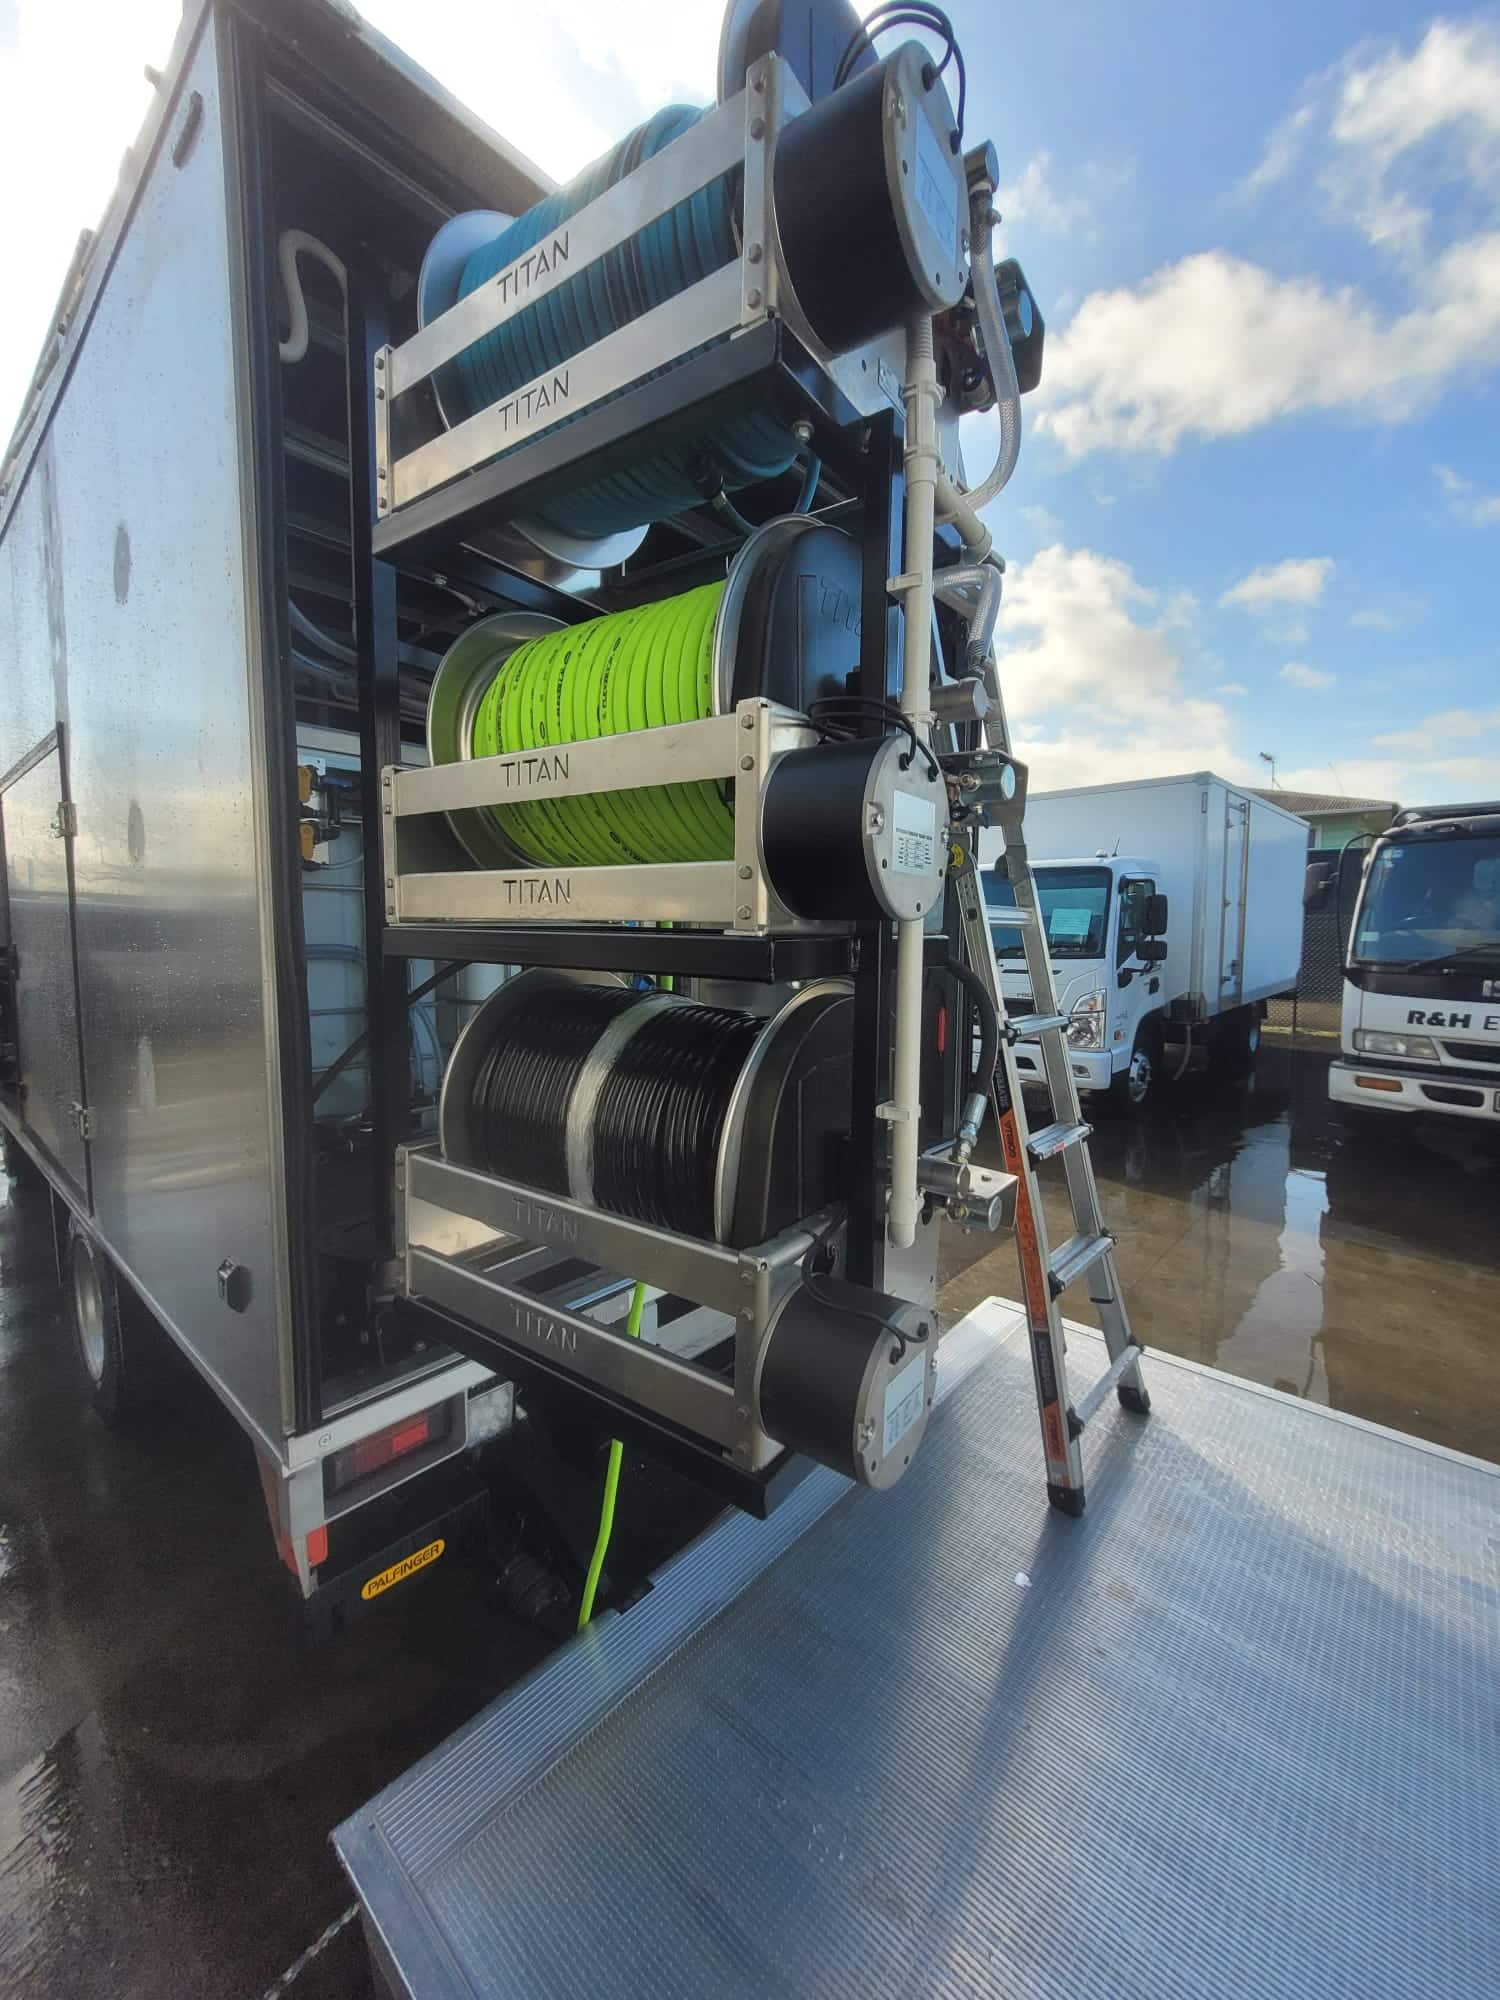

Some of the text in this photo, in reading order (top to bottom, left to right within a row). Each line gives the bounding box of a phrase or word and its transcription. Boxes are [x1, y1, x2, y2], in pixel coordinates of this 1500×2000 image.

[497, 230, 569, 303] TITAN
[498, 369, 569, 432] TITAN
[500, 752, 569, 787] TITAN
[502, 878, 570, 904] TITAN
[1407, 1010, 1472, 1029] R&H
[511, 1196, 579, 1242] TITAN
[510, 1303, 577, 1353] TITAN
[367, 1543, 440, 1596] PALFINGER
